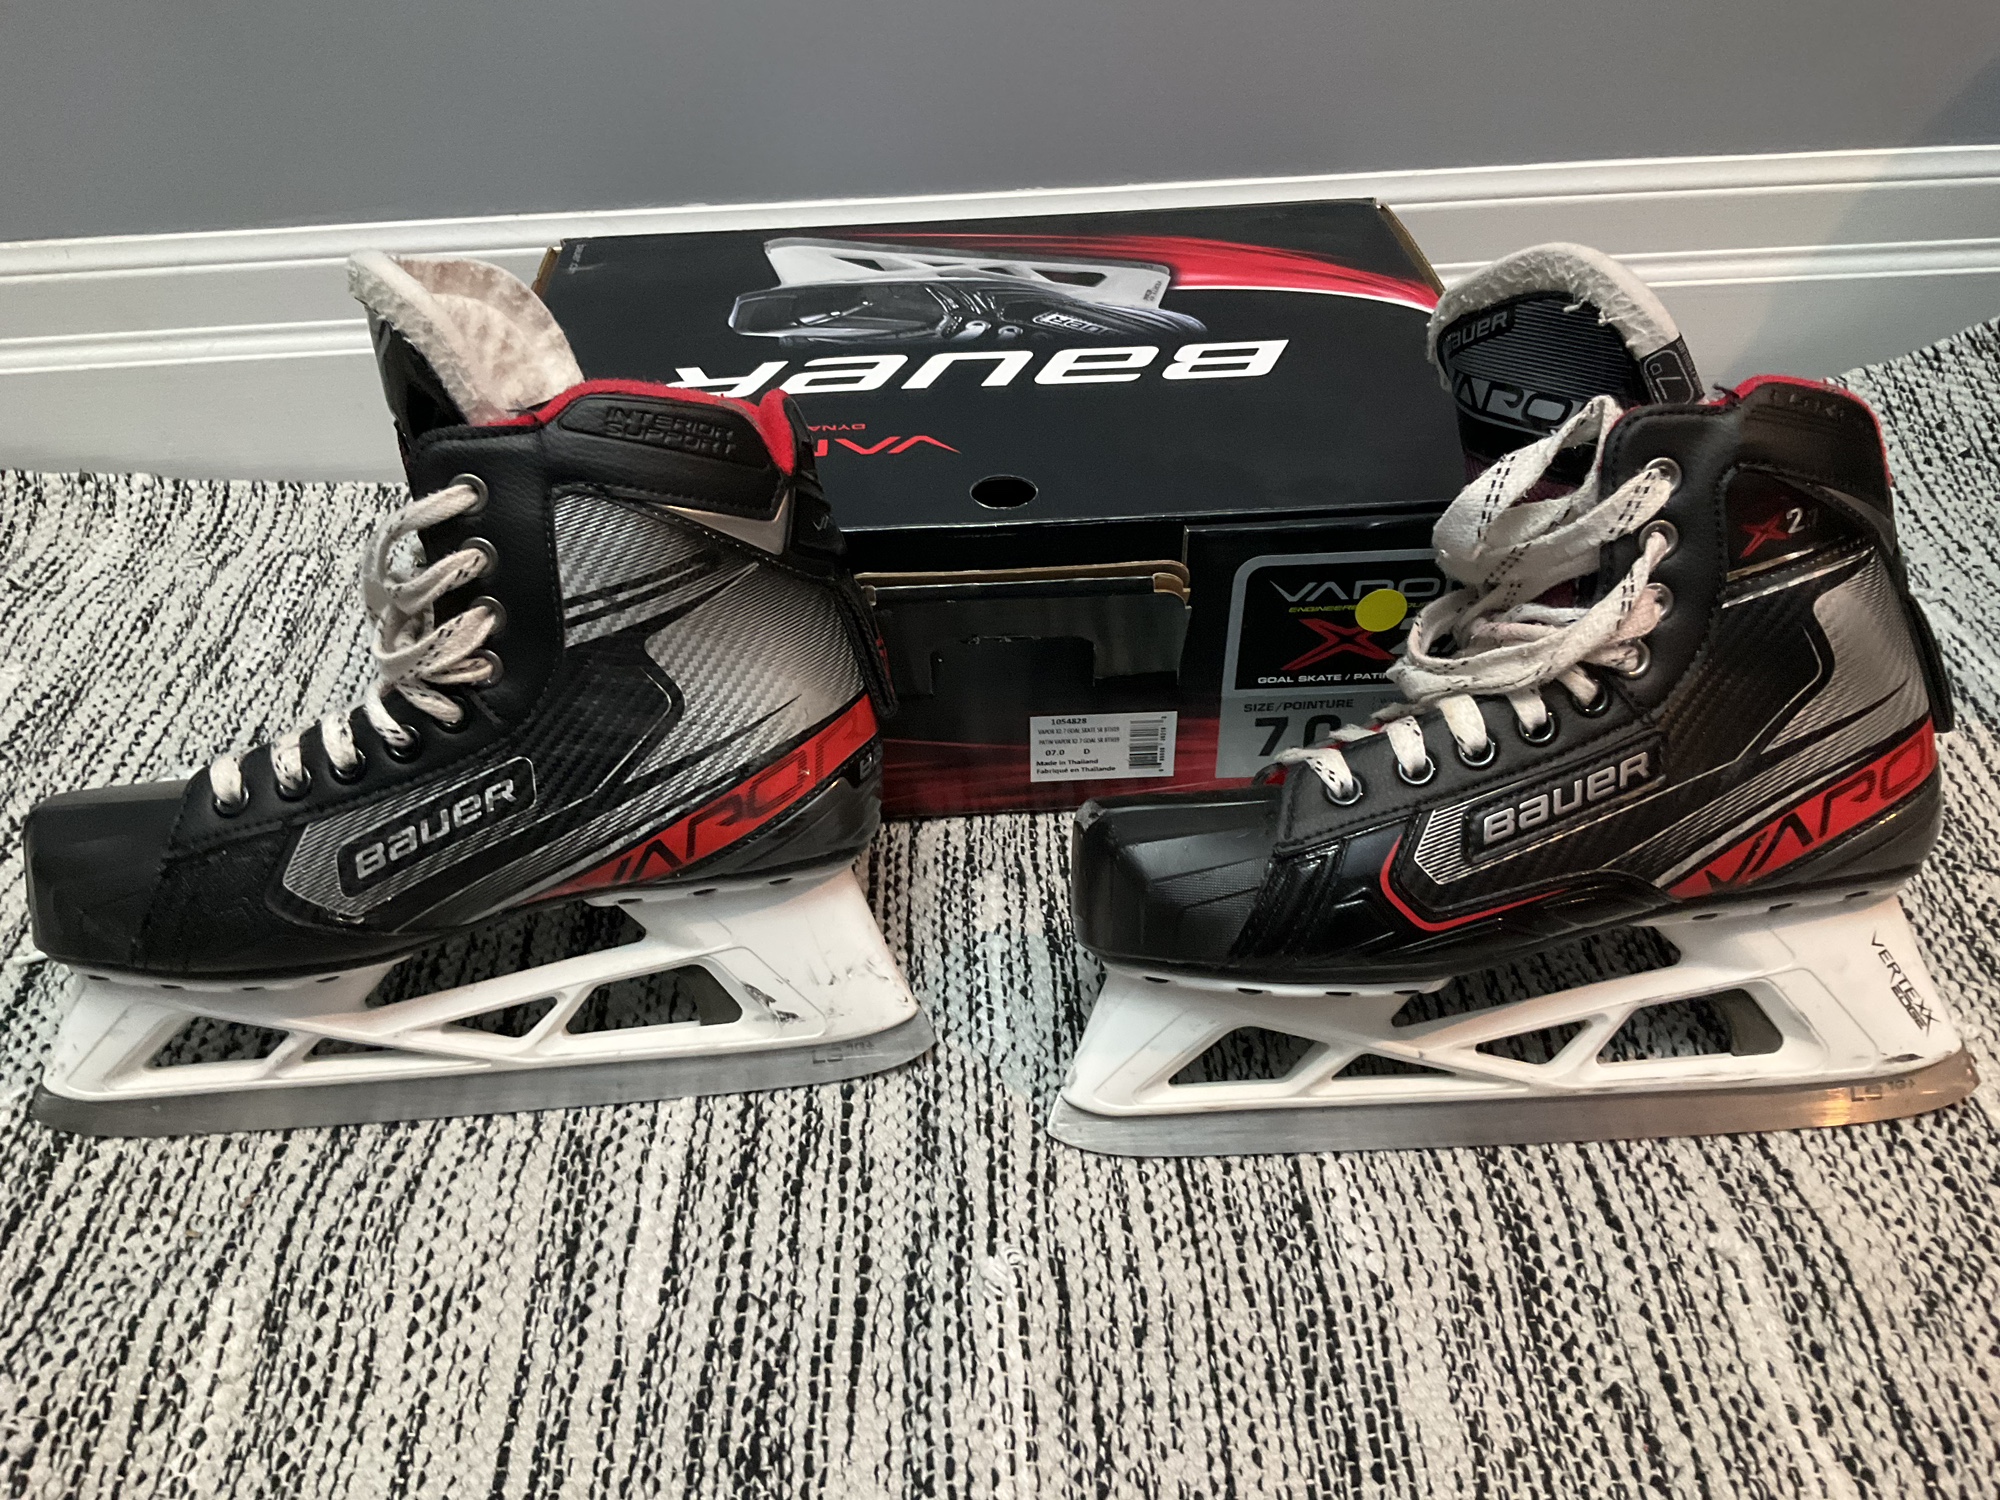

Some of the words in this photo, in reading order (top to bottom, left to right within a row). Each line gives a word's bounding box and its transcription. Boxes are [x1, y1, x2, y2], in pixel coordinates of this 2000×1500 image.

[1447, 311, 1508, 349] AUER
[604, 420, 737, 454] SUPPORT
[605, 406, 734, 440] INTERIOR
[807, 423, 867, 432] DYNA
[1269, 577, 1441, 602] VAPO
[1288, 604, 1357, 613] ENGINEERE
[1257, 676, 1294, 684] GOAL
[1298, 674, 1342, 683] SKATE
[1243, 699, 1354, 713] SIZE/POINTURE
[1704, 730, 1928, 892] VAPO
[1870, 930, 1941, 1038] VERTEXX
[1890, 985, 1929, 1031] EDGE
